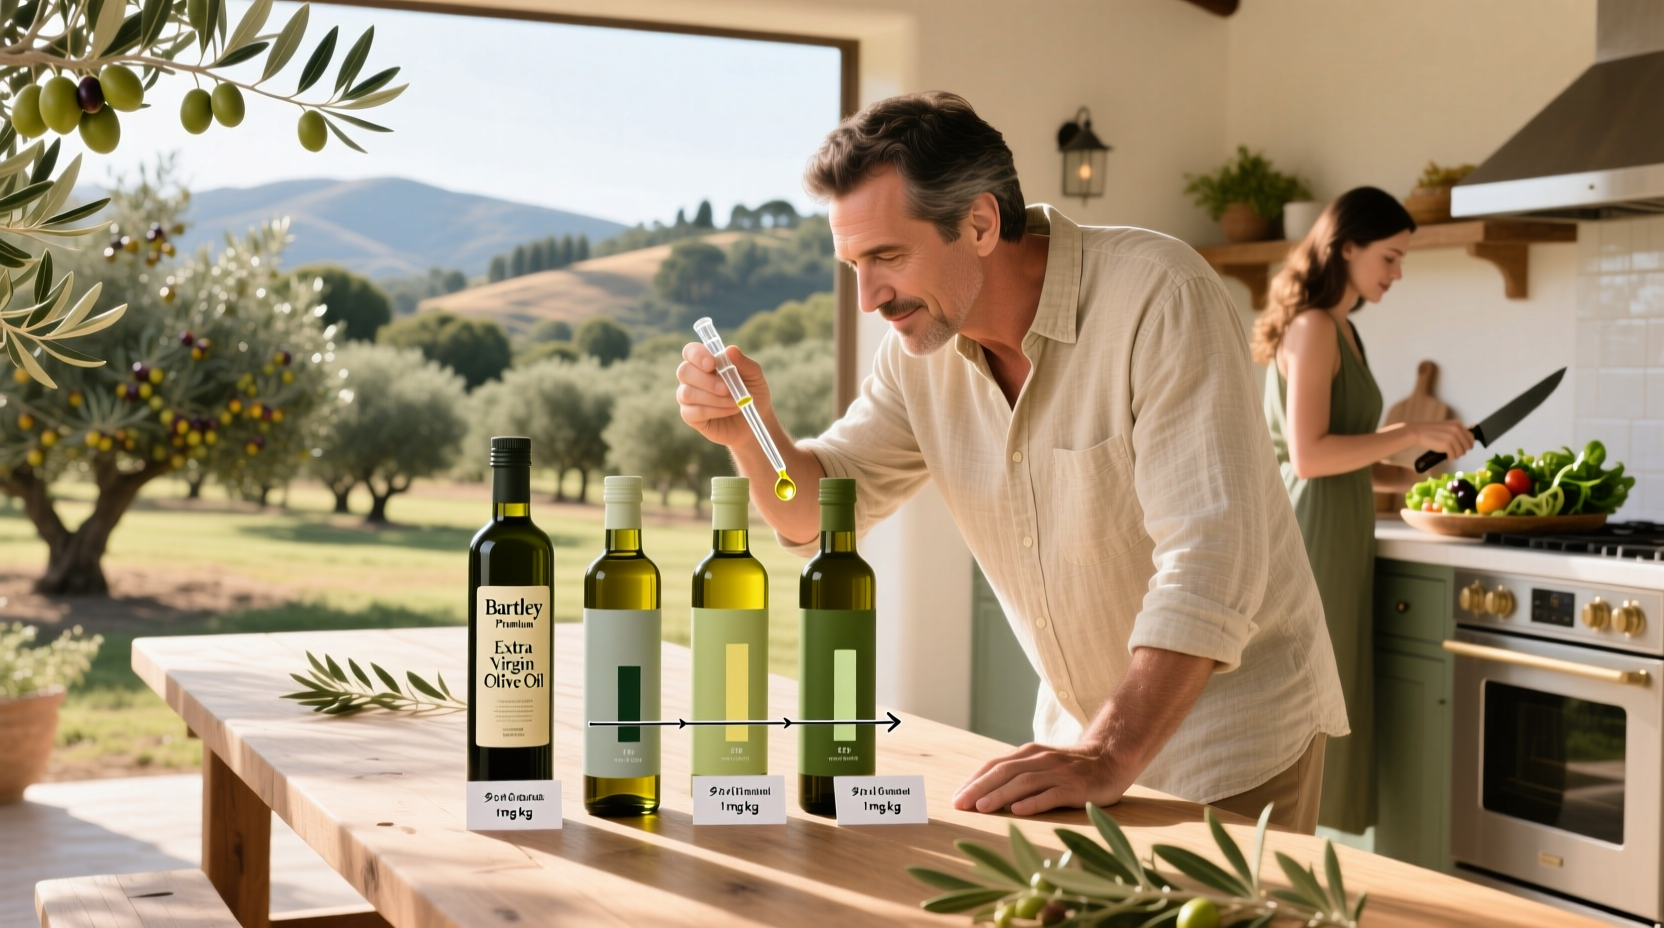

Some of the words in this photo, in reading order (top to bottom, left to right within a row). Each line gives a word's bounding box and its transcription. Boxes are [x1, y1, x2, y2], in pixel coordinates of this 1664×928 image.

[485, 598, 543, 620] Bartley
[494, 640, 533, 654] Extra
[490, 656, 535, 674] Virgin
[484, 673, 521, 689] Olive
[523, 673, 544, 688] Oil
